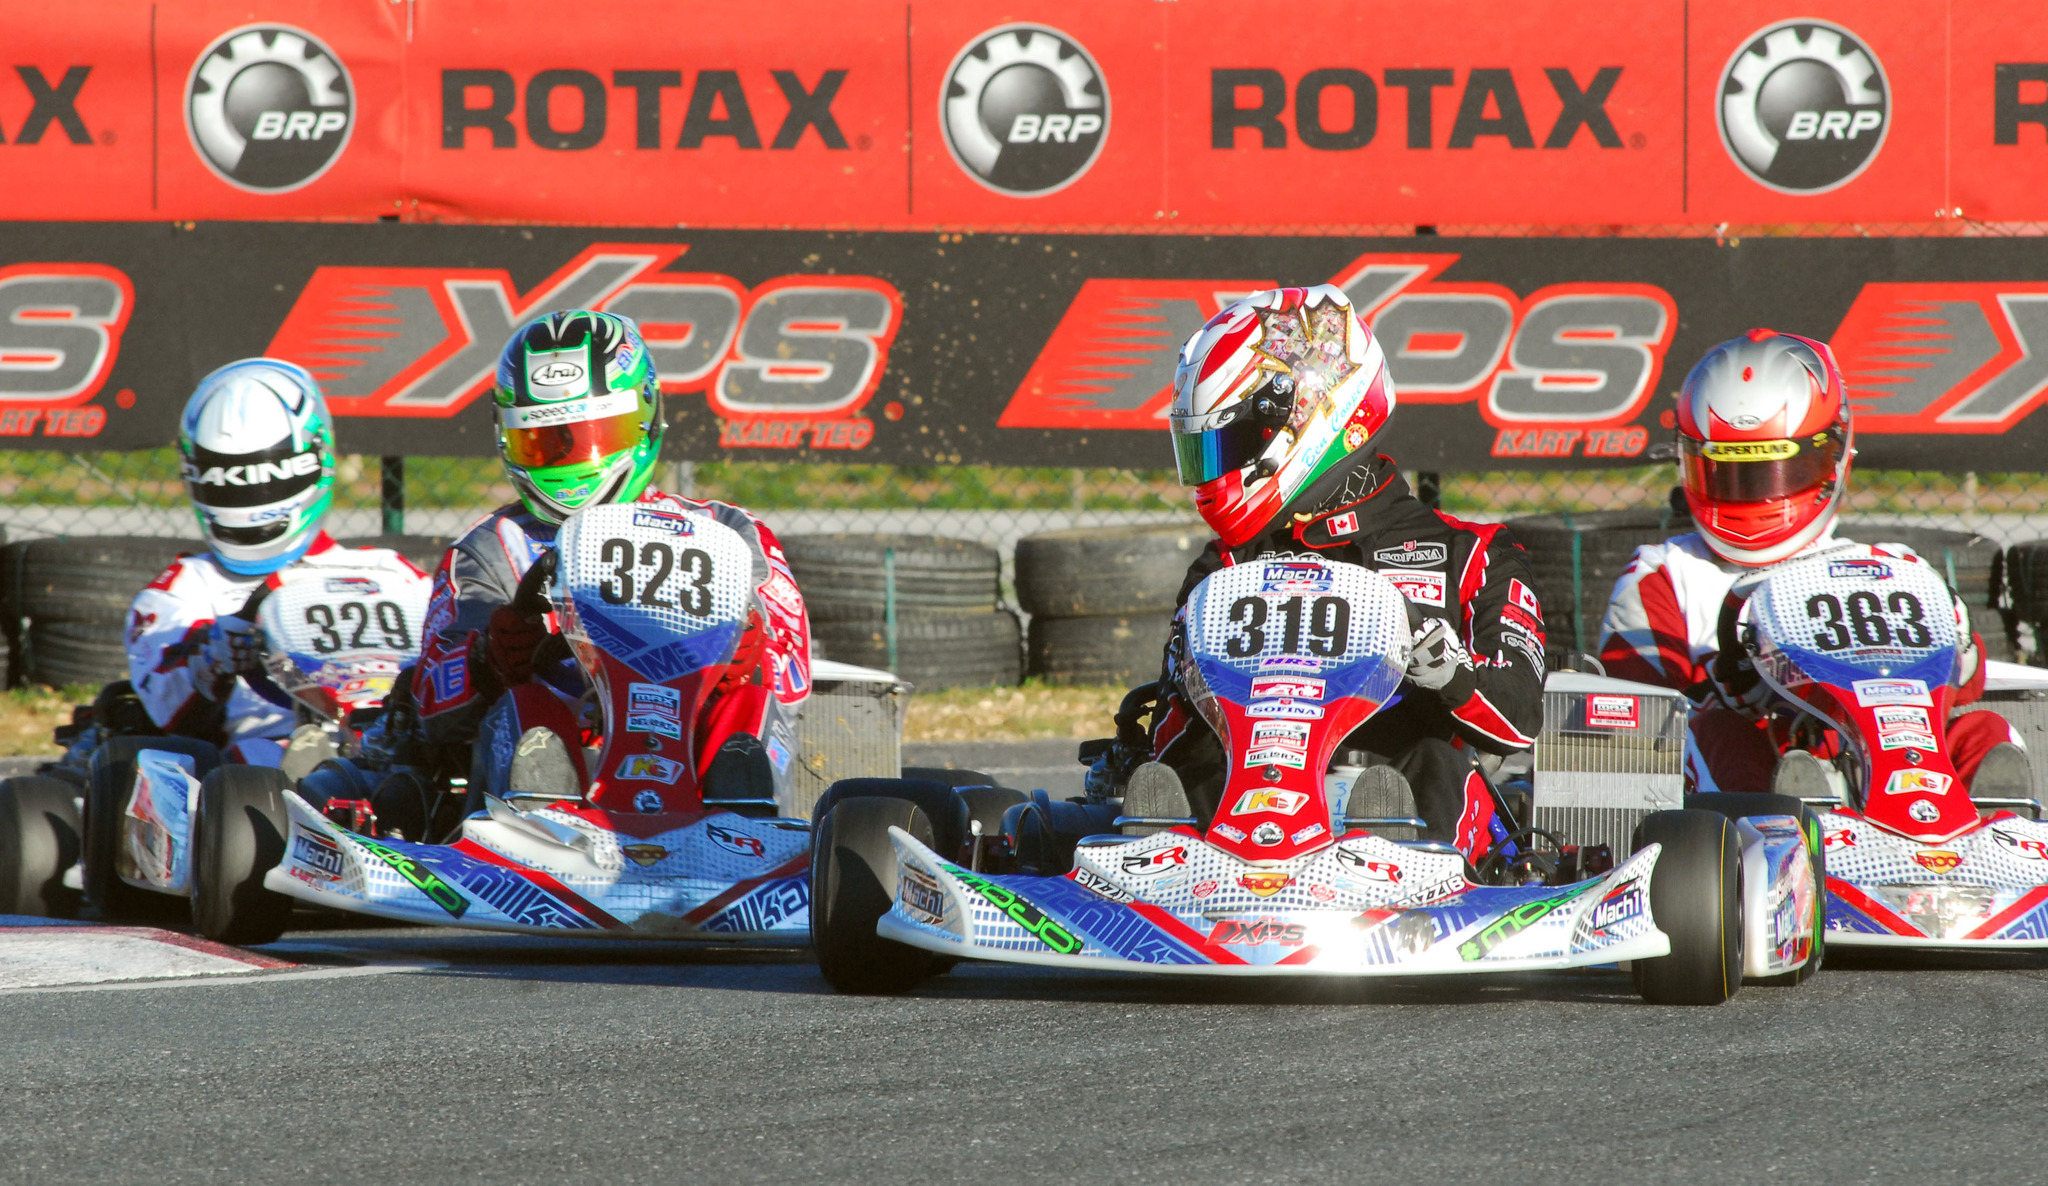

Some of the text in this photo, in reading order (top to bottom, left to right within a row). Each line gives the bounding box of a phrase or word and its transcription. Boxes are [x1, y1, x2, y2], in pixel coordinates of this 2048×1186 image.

[440, 69, 850, 150] ROTAX
[1210, 67, 1626, 150] ROTAX
[253, 111, 347, 140] BRP
[1008, 115, 1103, 143] BRP
[1785, 110, 1882, 139] BRP
[385, 253, 894, 412] XPS
[0, 409, 102, 433] RT TEC
[725, 420, 871, 446] KART TEC
[1496, 429, 1646, 455] KART TEC
[634, 514, 692, 533] Mach1
[1380, 548, 1443, 563] SOFINA
[600, 538, 712, 617] 323
[1266, 568, 1329, 581] Mach1
[305, 601, 413, 653] 329
[1226, 596, 1351, 659] 319
[1805, 591, 1932, 651] 363
[1253, 706, 1316, 716] SOFINA
[902, 877, 943, 917] Mach1
[1595, 889, 1640, 929] Mach1
[1232, 917, 1307, 944] XPS
